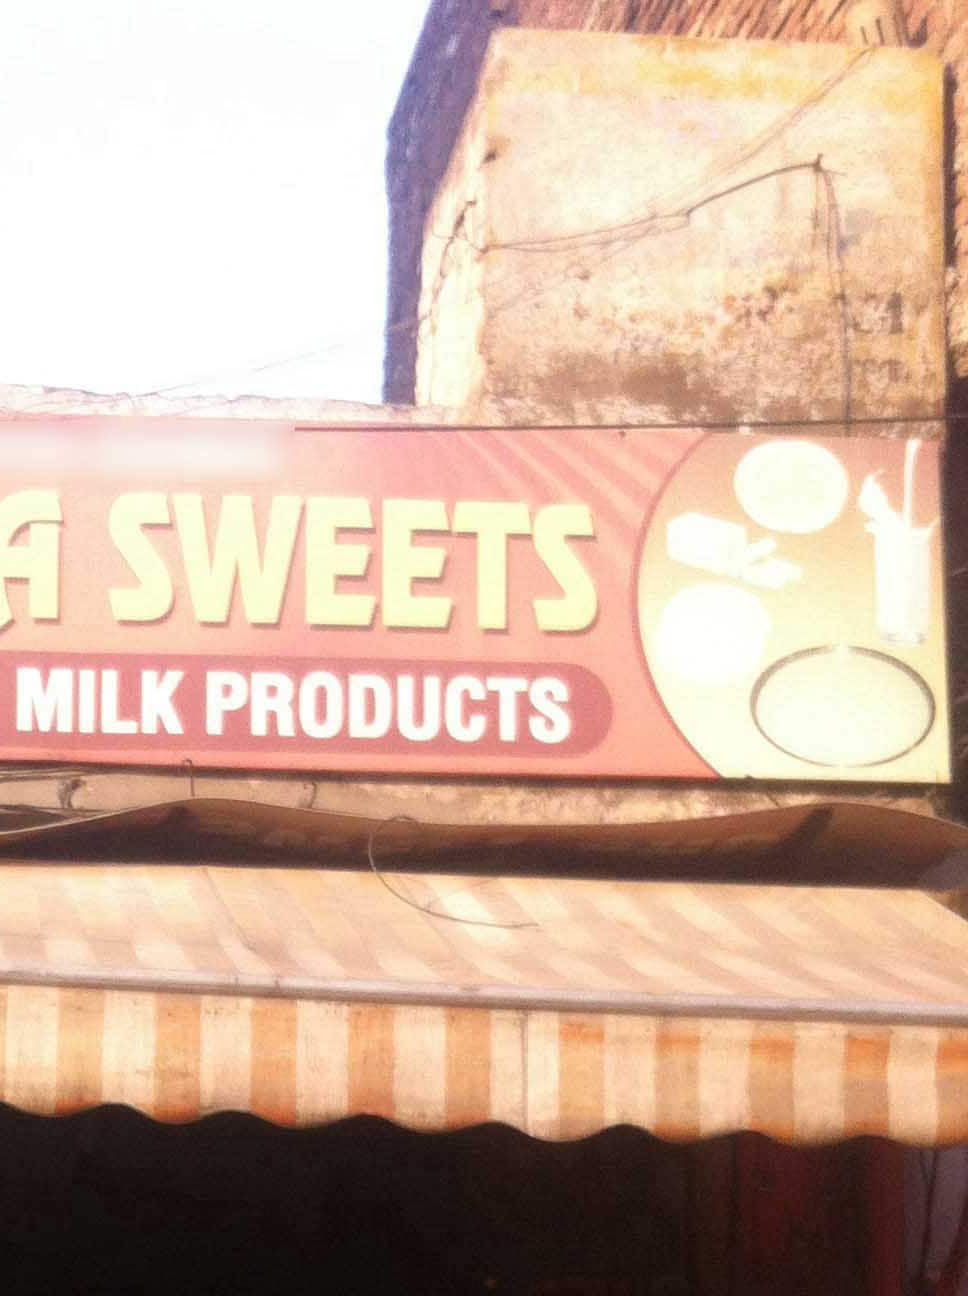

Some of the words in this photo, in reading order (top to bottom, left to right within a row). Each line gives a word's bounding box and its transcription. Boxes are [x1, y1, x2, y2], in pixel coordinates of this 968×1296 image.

[107, 490, 599, 636] SWEETS
[15, 668, 186, 737] MILK
[205, 671, 573, 744] PRODUCTS
